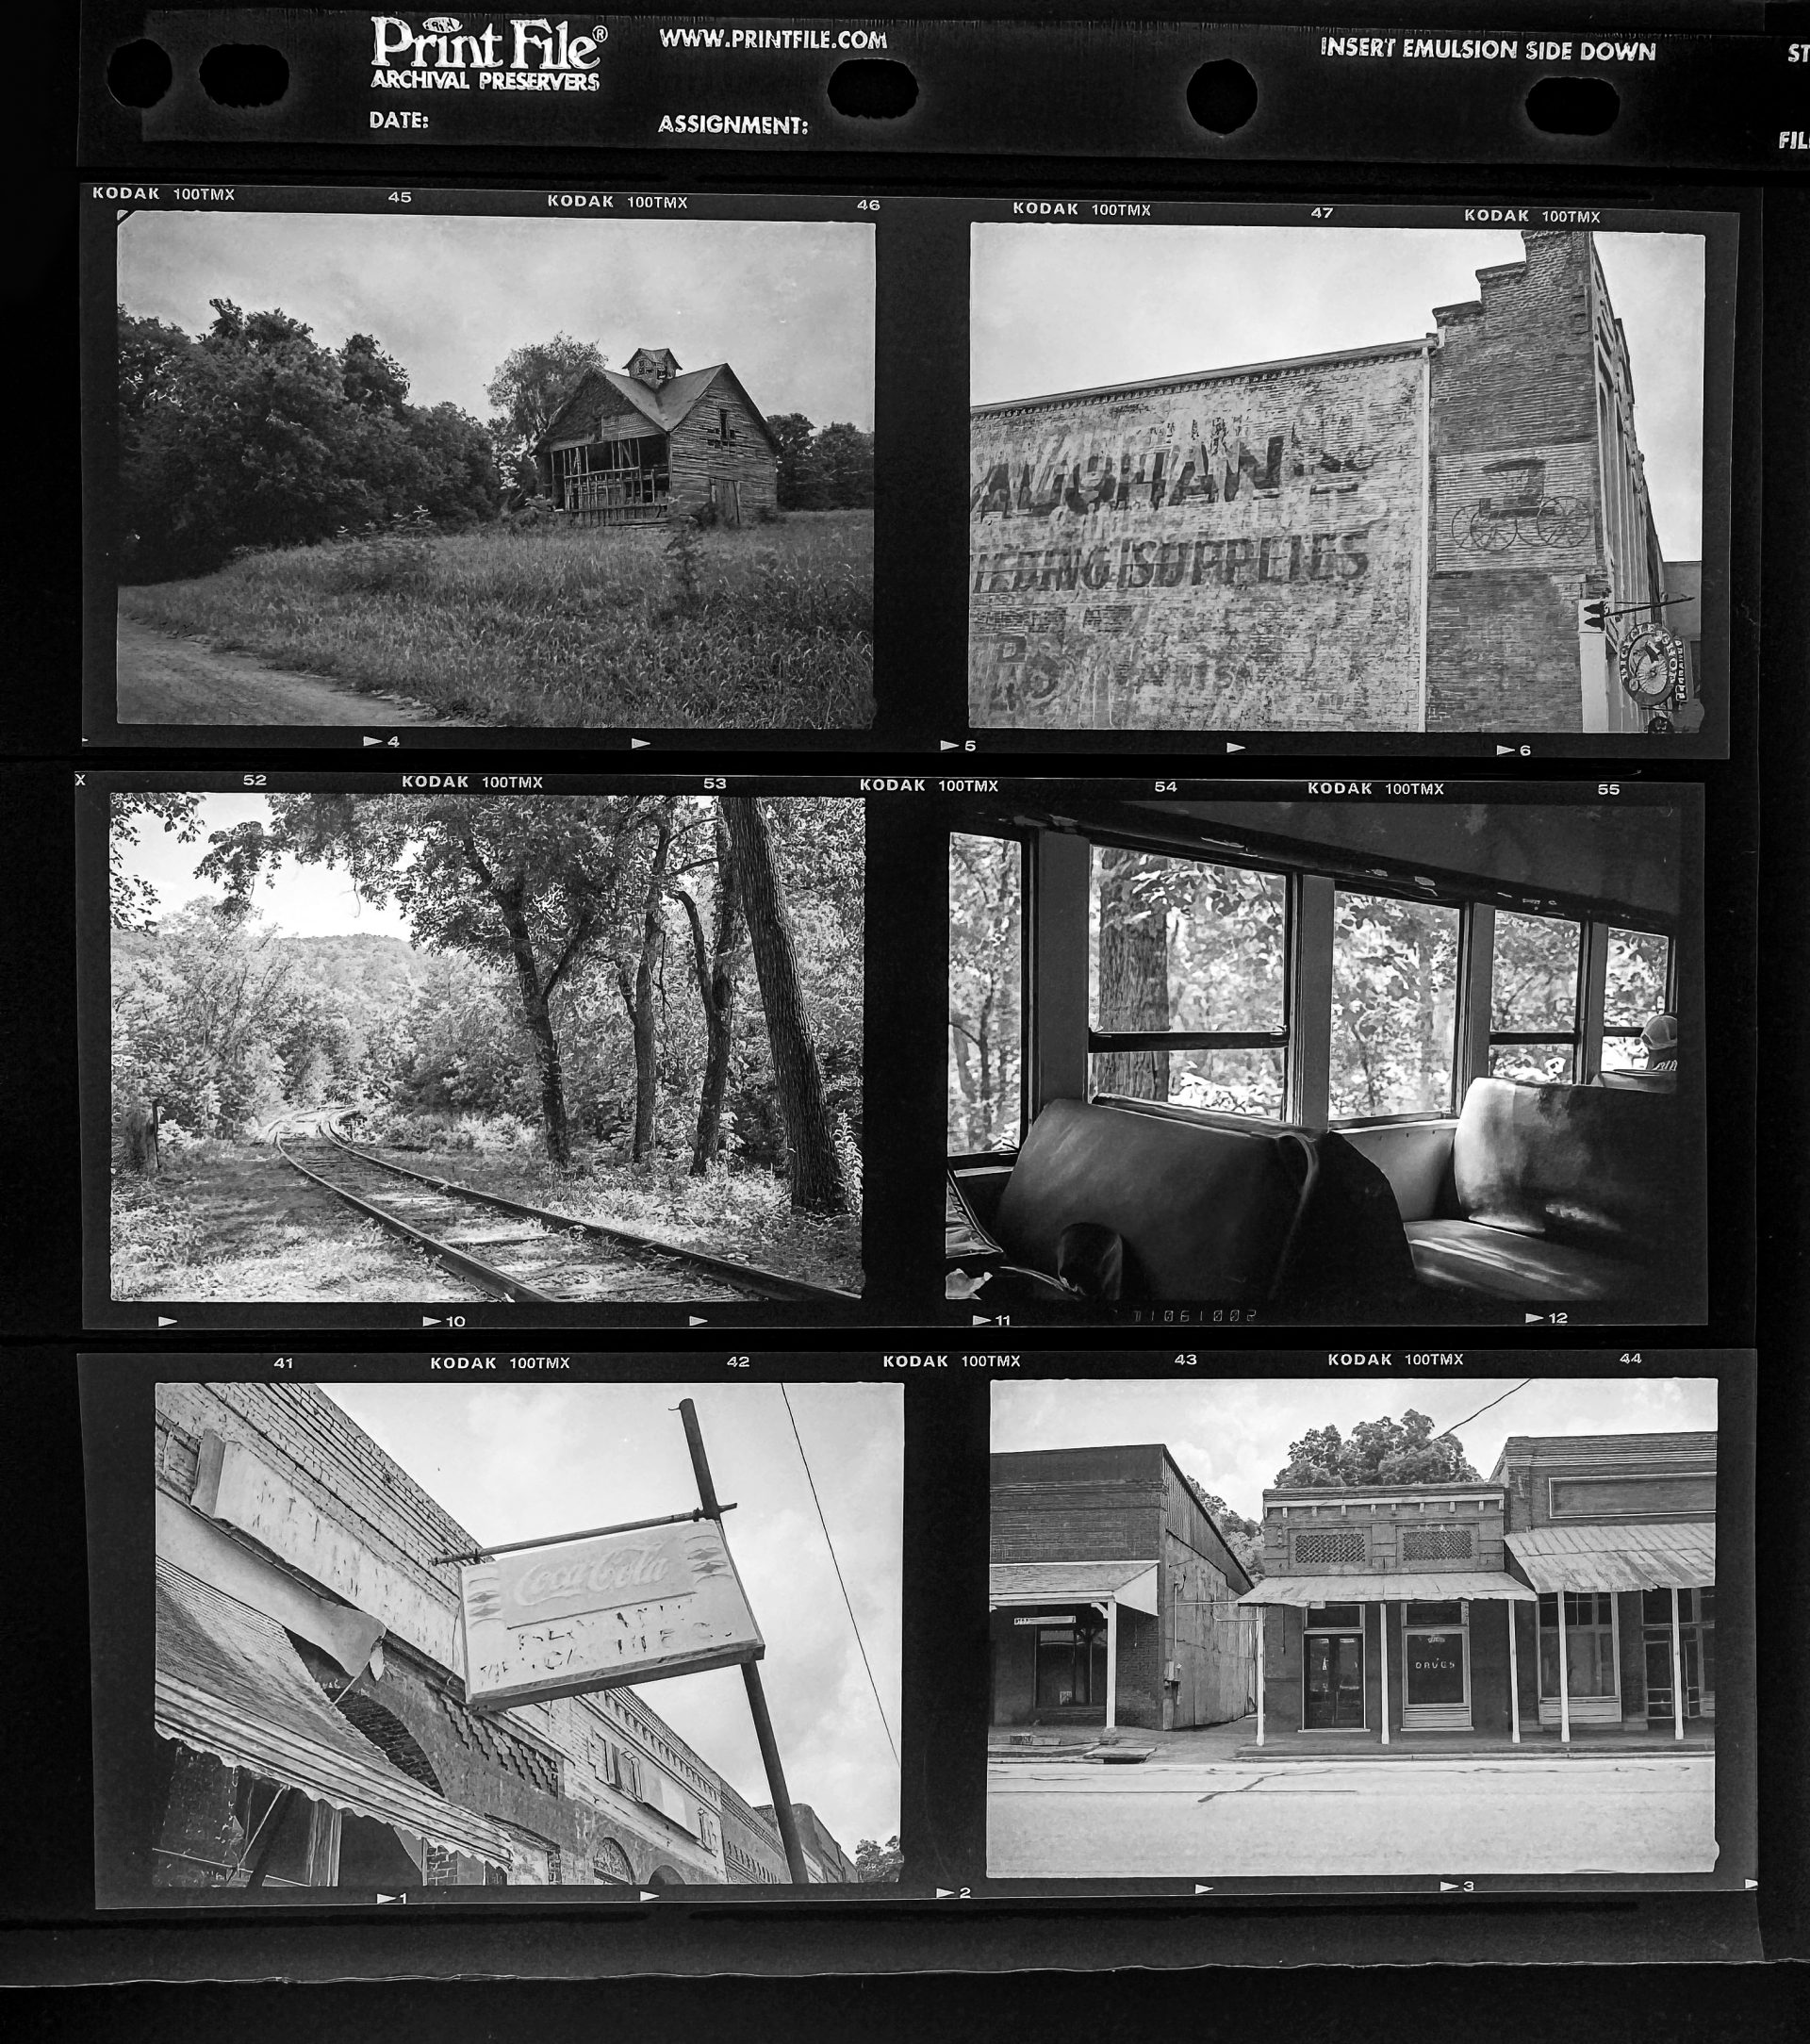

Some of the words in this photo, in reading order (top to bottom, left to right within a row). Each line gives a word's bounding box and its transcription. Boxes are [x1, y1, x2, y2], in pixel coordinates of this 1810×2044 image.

[370, 16, 503, 68] Print
[659, 29, 888, 50] WWW.PRINTFILE.COM
[1322, 36, 1397, 58] INSERT
[1403, 39, 1518, 59] EMULSION
[1526, 41, 1572, 60] SIDE
[1581, 42, 1656, 62] DOWN
[370, 70, 469, 90] ARCHIVAL
[479, 71, 601, 91] PRESERVERS
[370, 111, 429, 129] DATE:
[658, 115, 809, 135] ASSIGNMENT:
[1778, 131, 1810, 150] FIL
[92, 188, 160, 200] KODAK
[173, 189, 235, 201] 100TMX
[387, 191, 412, 204] 45
[548, 195, 614, 208] KODAK
[627, 197, 688, 209] 100TMX
[857, 199, 880, 211] 46
[1013, 202, 1078, 215] KODAK
[1093, 203, 1153, 216] 100TMX
[1311, 206, 1336, 218] 47
[1464, 209, 1529, 223] KODAK
[1541, 211, 1601, 223] 100TMX
[387, 736, 401, 749] 4
[965, 741, 977, 752] 5
[1521, 745, 1532, 757] 6
[242, 775, 267, 786] 52
[402, 773, 469, 788] KODAK
[483, 777, 543, 789] 100TMX
[703, 777, 727, 789] 53
[861, 777, 926, 792] KODAK
[938, 781, 998, 793] 100TMX
[1154, 779, 1177, 793] 54
[1308, 782, 1373, 795] KODAK
[1385, 783, 1445, 796] 100TMX
[1597, 782, 1621, 796] 55
[445, 1315, 467, 1329] 10
[995, 1314, 1011, 1327] 11
[1548, 1312, 1569, 1327] 12
[274, 1358, 293, 1369] 41
[431, 1358, 497, 1370] KODAK
[510, 1358, 570, 1370] 100TMX
[727, 1357, 750, 1368] 42
[883, 1356, 948, 1368] KODAK
[962, 1356, 1021, 1367] 100TMX
[1175, 1355, 1197, 1366] 43
[1328, 1354, 1392, 1366] KODAK
[1405, 1354, 1464, 1366] 100TMX
[1619, 1354, 1642, 1364] 44
[960, 1887, 971, 1899] 2
[1464, 1881, 1475, 1893] 3
[399, 1892, 406, 1904] 1
